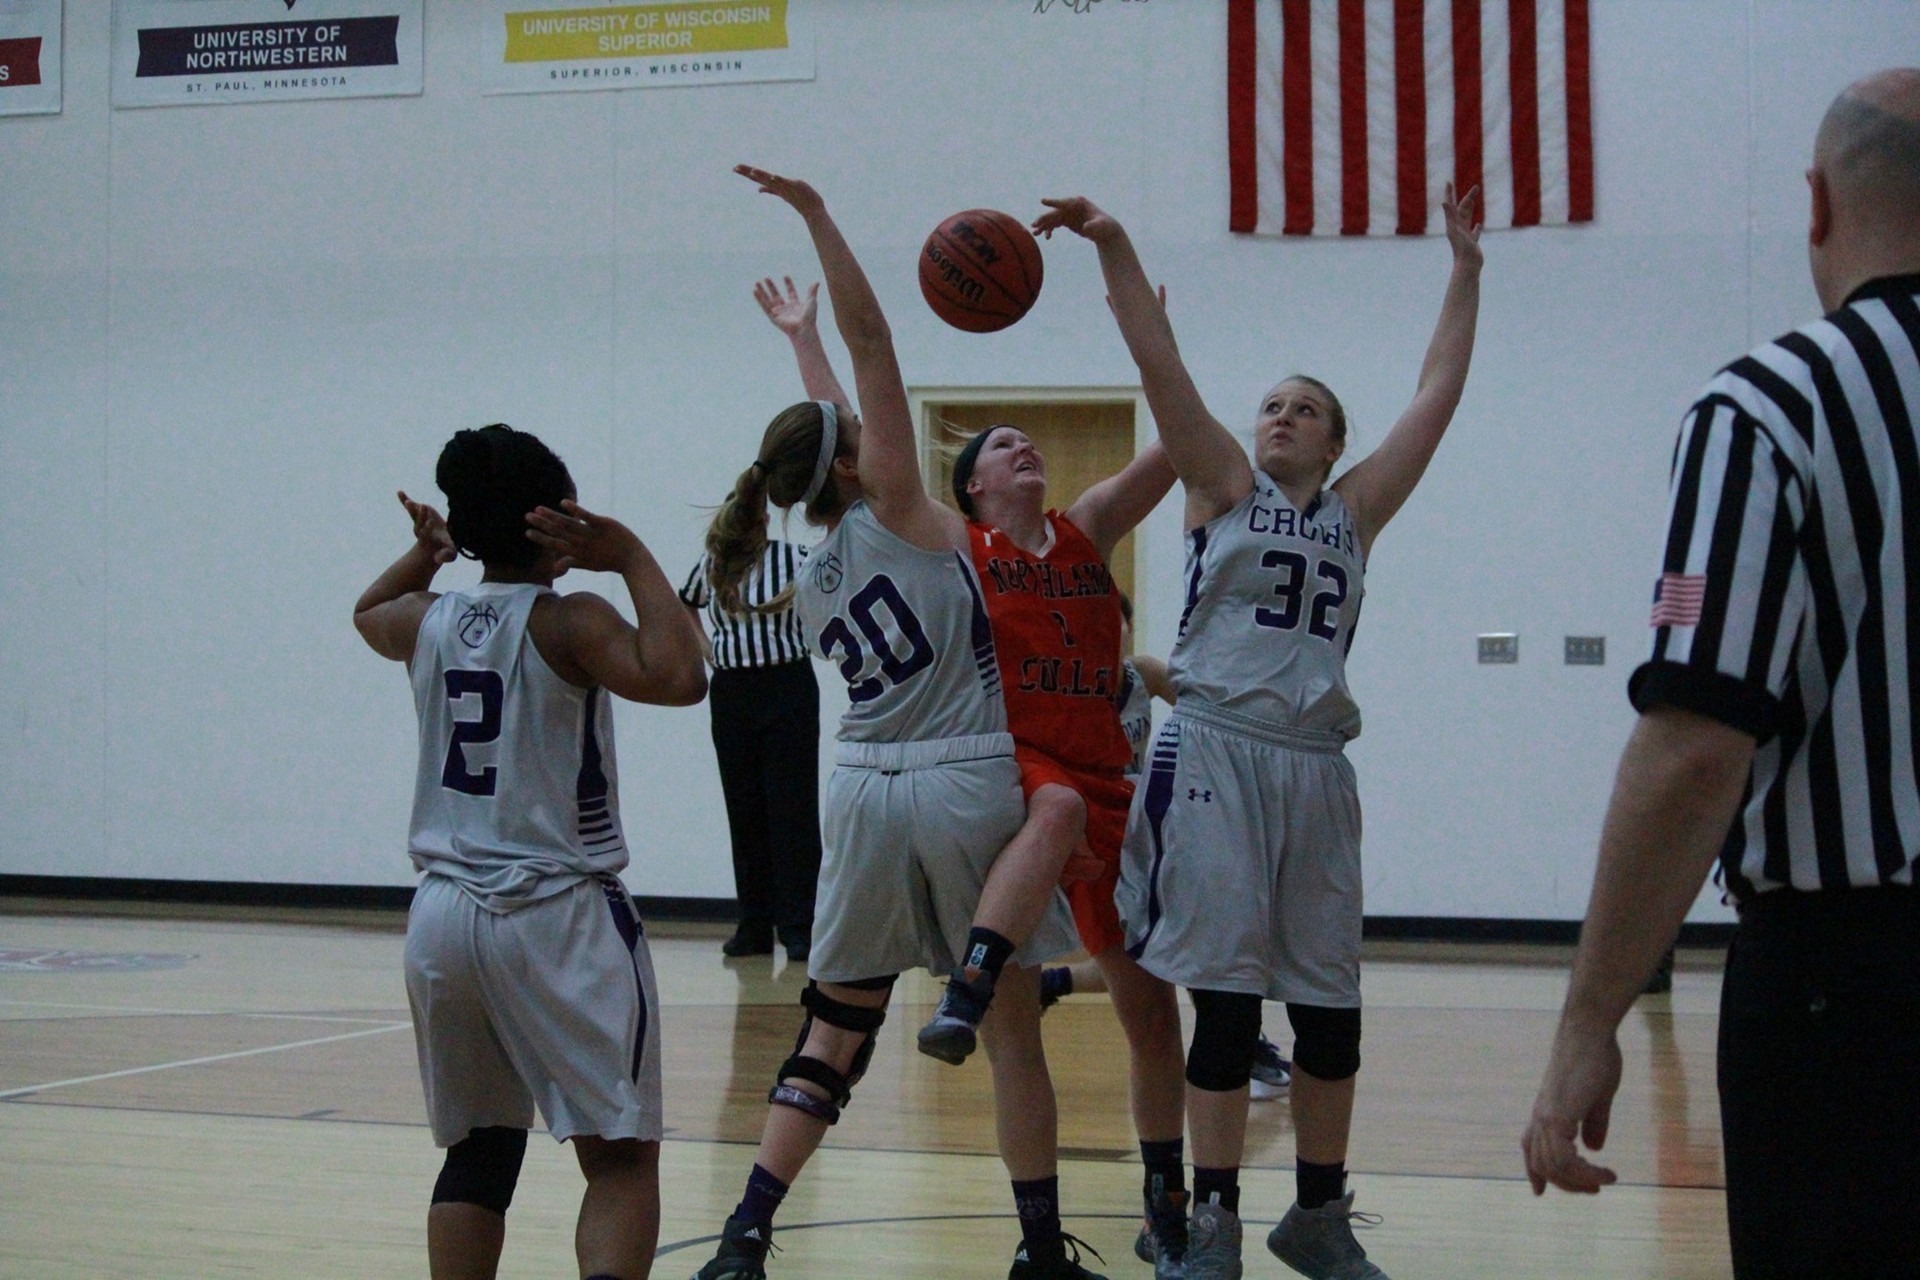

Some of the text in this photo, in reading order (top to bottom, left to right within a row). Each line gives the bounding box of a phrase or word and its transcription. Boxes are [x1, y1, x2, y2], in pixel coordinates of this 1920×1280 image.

[523, 6, 771, 36] UNIVERSITY OF WISCONSIN
[193, 25, 342, 50] UNIVERSITY OF
[598, 32, 694, 52] SUPERIOR
[185, 45, 349, 70] NORTHWESTERN
[649, 60, 743, 75] WISCONSIN
[186, 82, 207, 94] ST.
[263, 76, 349, 90] MINNESOTA
[1254, 549, 1348, 643] 32
[818, 572, 936, 704] 20
[441, 668, 504, 797] 2
